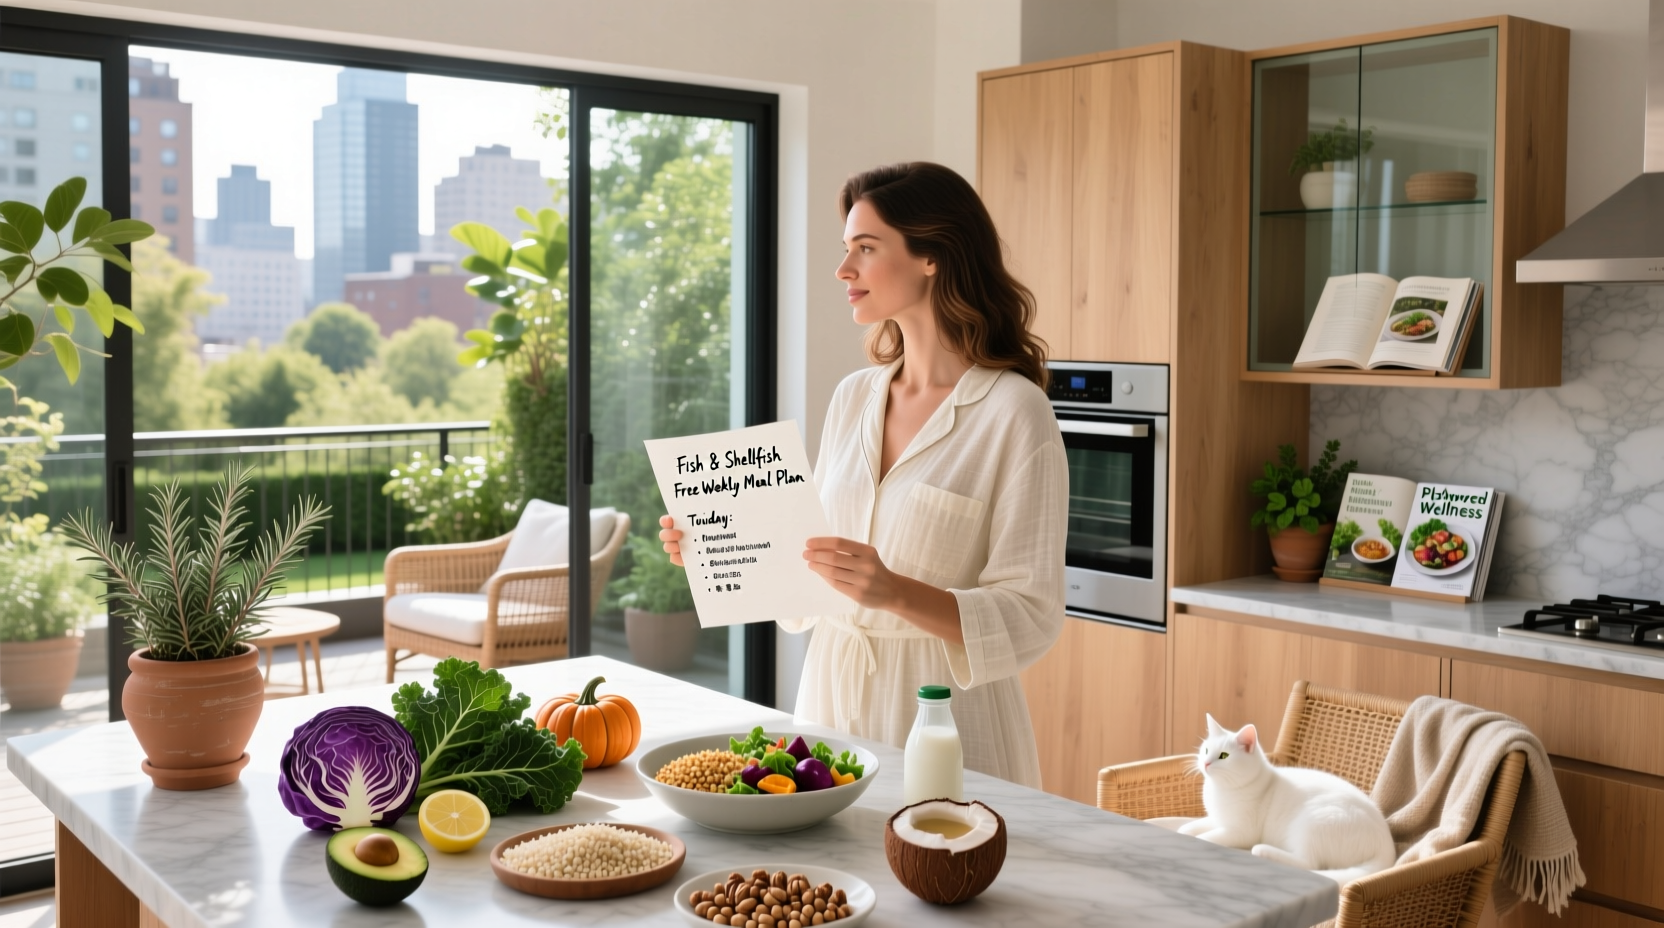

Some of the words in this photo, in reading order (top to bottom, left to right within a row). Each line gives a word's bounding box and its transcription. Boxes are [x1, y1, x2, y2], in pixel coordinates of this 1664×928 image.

[676, 455, 703, 474] Fish
[710, 453, 719, 470] &
[725, 446, 782, 469] Shellfish
[674, 483, 699, 498] Free
[777, 469, 804, 486] Plan
[1421, 502, 1482, 519] Wellness
